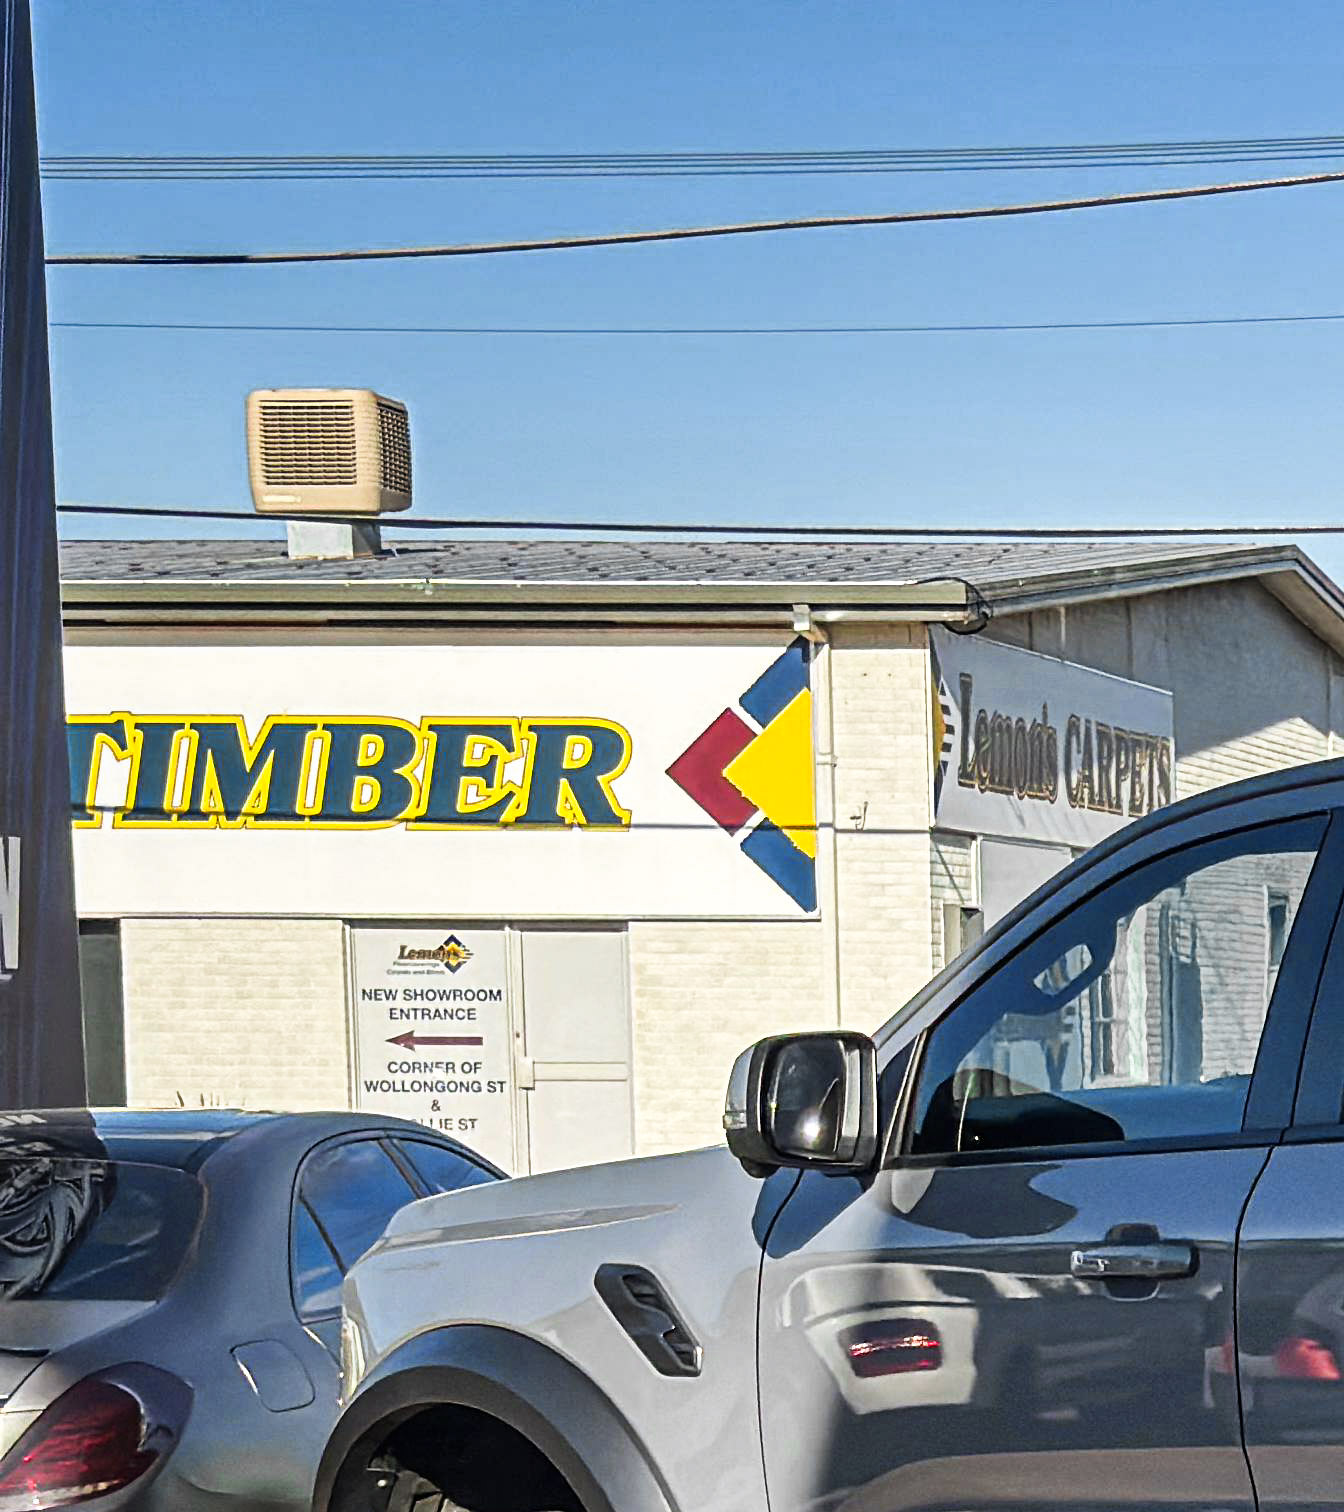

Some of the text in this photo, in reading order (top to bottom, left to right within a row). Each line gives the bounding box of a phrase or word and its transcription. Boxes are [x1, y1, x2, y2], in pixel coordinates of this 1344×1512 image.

[66, 711, 633, 831] TIMBER
[1066, 713, 1180, 818] CARPETS
[361, 989, 502, 1001] NEW SHOWROOM
[389, 1008, 477, 1020] ENTRANCE
[461, 1061, 482, 1074] OF
[364, 1080, 506, 1093] WOLLONGONG ST
[431, 1099, 441, 1111] &
[458, 1118, 478, 1131] ST
